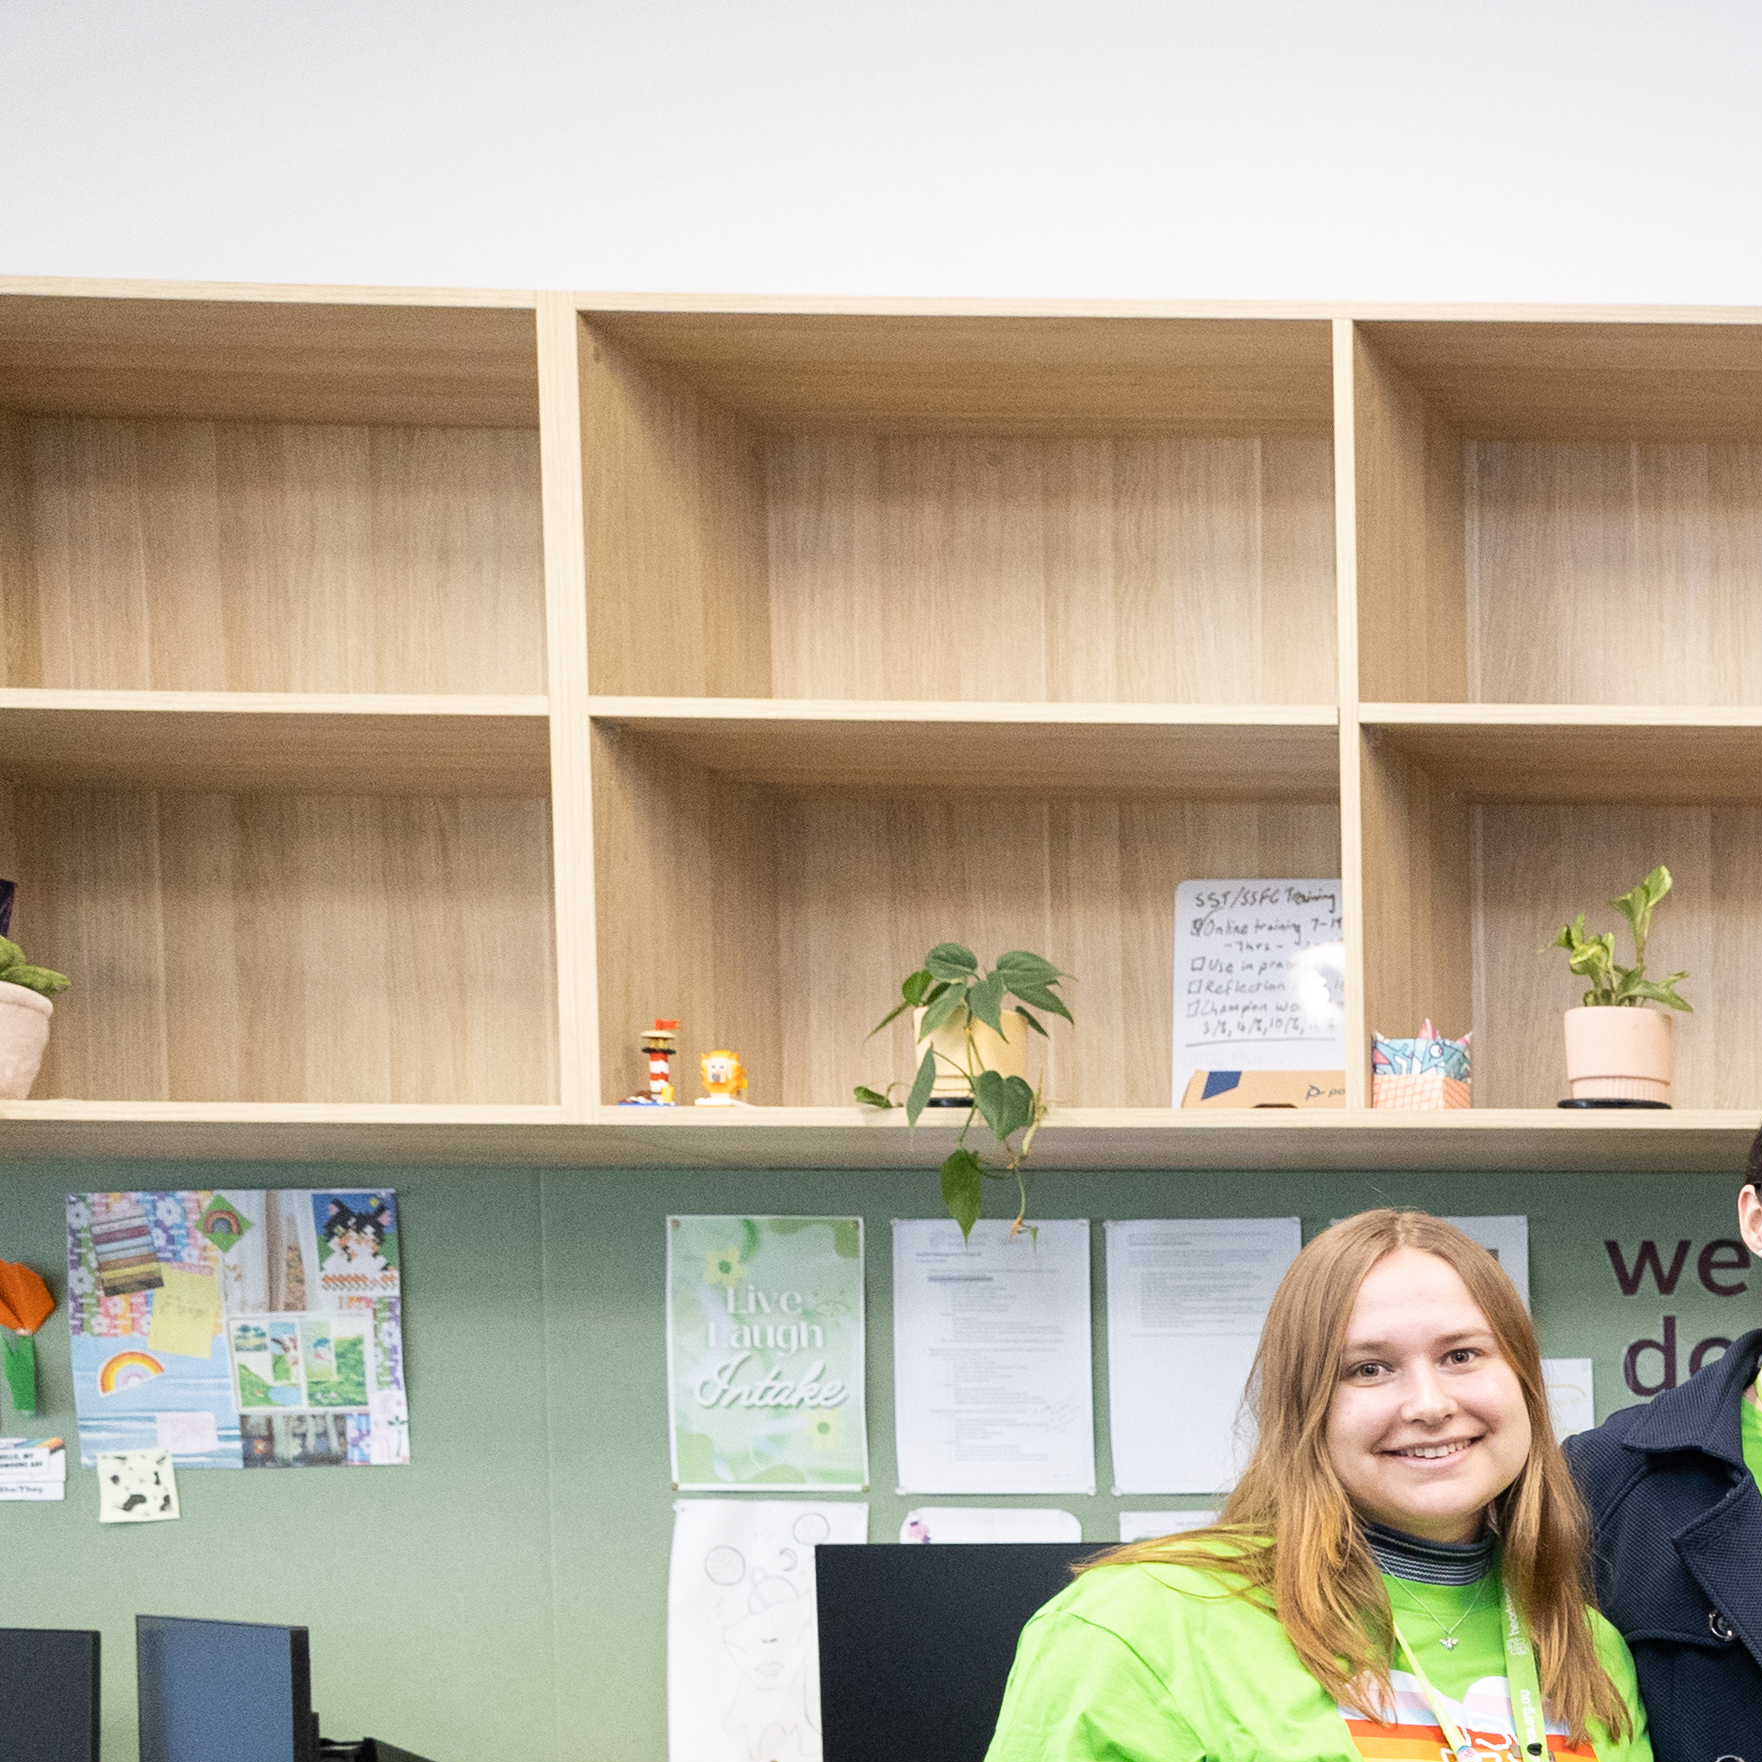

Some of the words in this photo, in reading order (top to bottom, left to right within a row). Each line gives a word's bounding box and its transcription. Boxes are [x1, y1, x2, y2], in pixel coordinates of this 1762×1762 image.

[1205, 979, 1286, 996] Reflection
[1604, 1237, 1752, 1298] we
[726, 1283, 803, 1315] Live
[708, 1320, 825, 1356] Laugh
[695, 1350, 850, 1409] Intake
